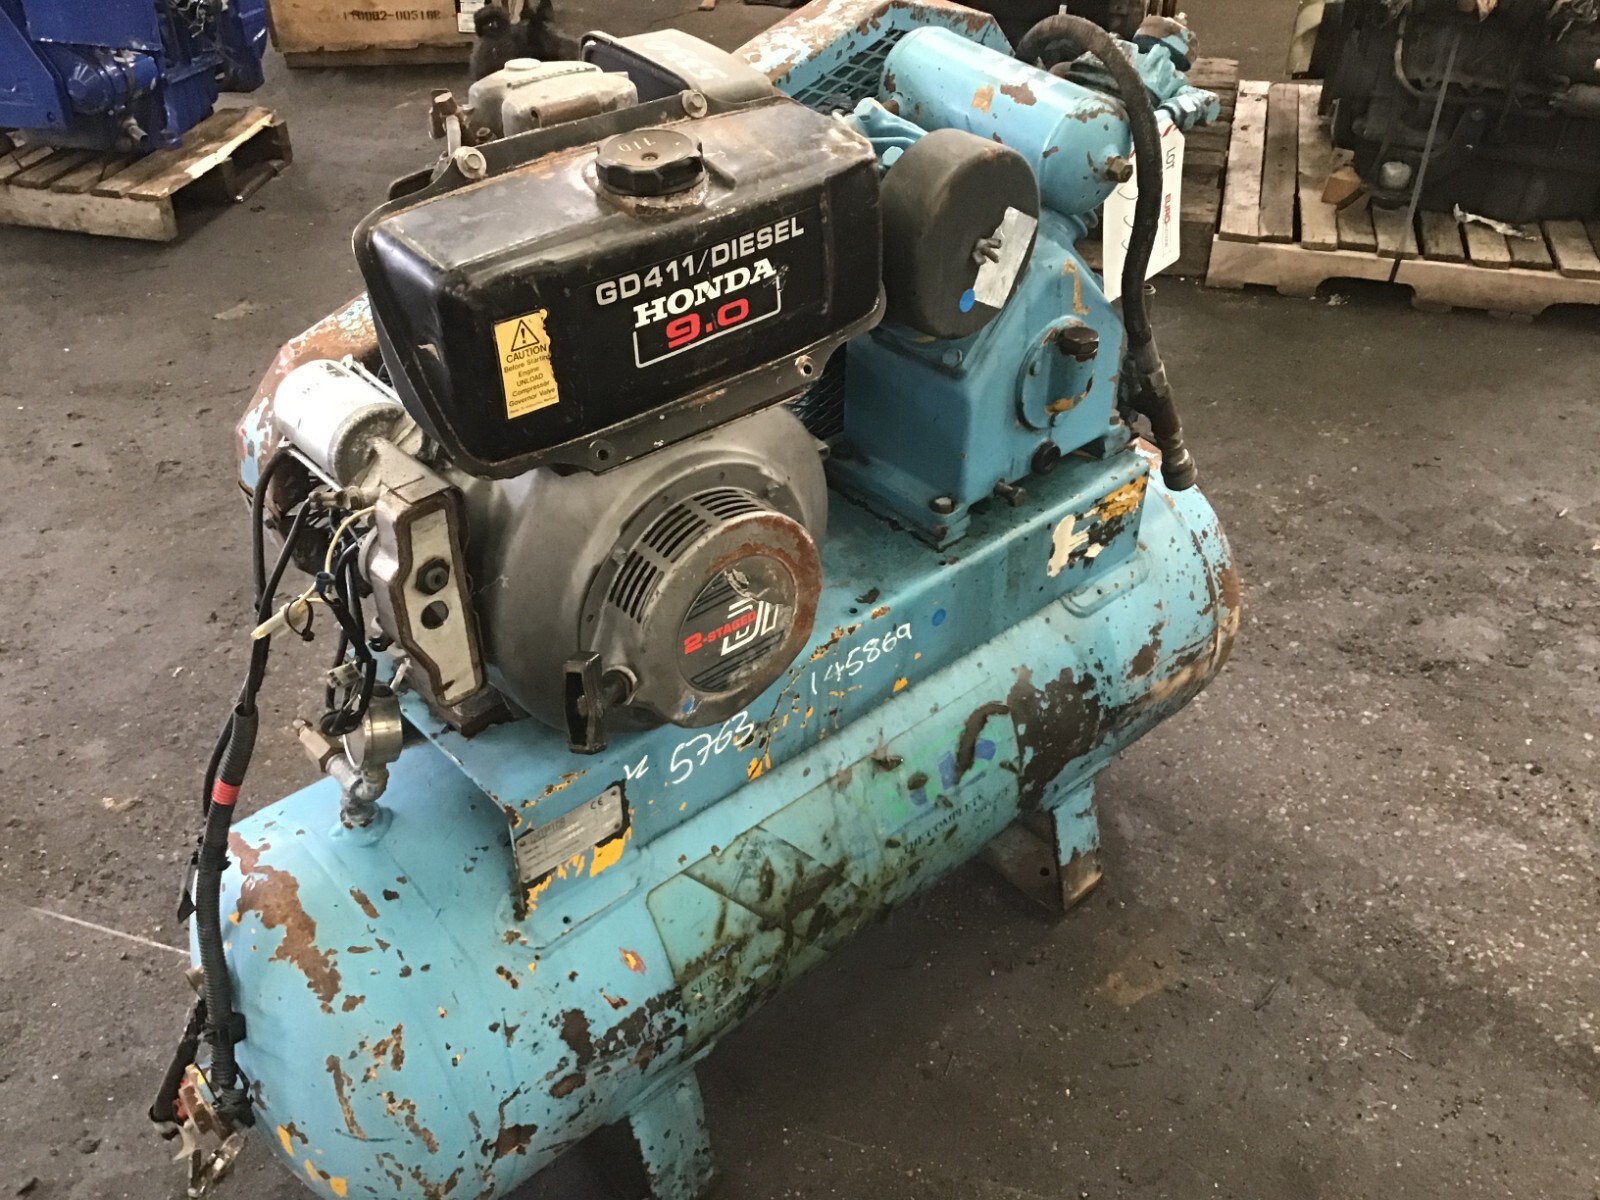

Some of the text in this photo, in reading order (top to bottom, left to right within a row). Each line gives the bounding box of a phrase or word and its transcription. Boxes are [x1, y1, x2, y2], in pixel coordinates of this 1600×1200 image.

[1165, 146, 1176, 170] LOT
[1163, 193, 1172, 225] EURO
[595, 216, 804, 305] GD411/DIESEL
[633, 258, 777, 328] HONDA
[666, 298, 749, 349] 9.0
[506, 343, 547, 363] CAUTION
[504, 361, 525, 373] Before
[518, 366, 540, 378] Engine
[512, 380, 550, 397] Compressor
[516, 373, 544, 387] UNLOAD
[508, 393, 537, 407] Governor
[539, 387, 556, 397] Valve
[683, 610, 757, 655] 2-STAGED
[669, 710, 755, 785] 5763
[810, 622, 912, 695] 145869
